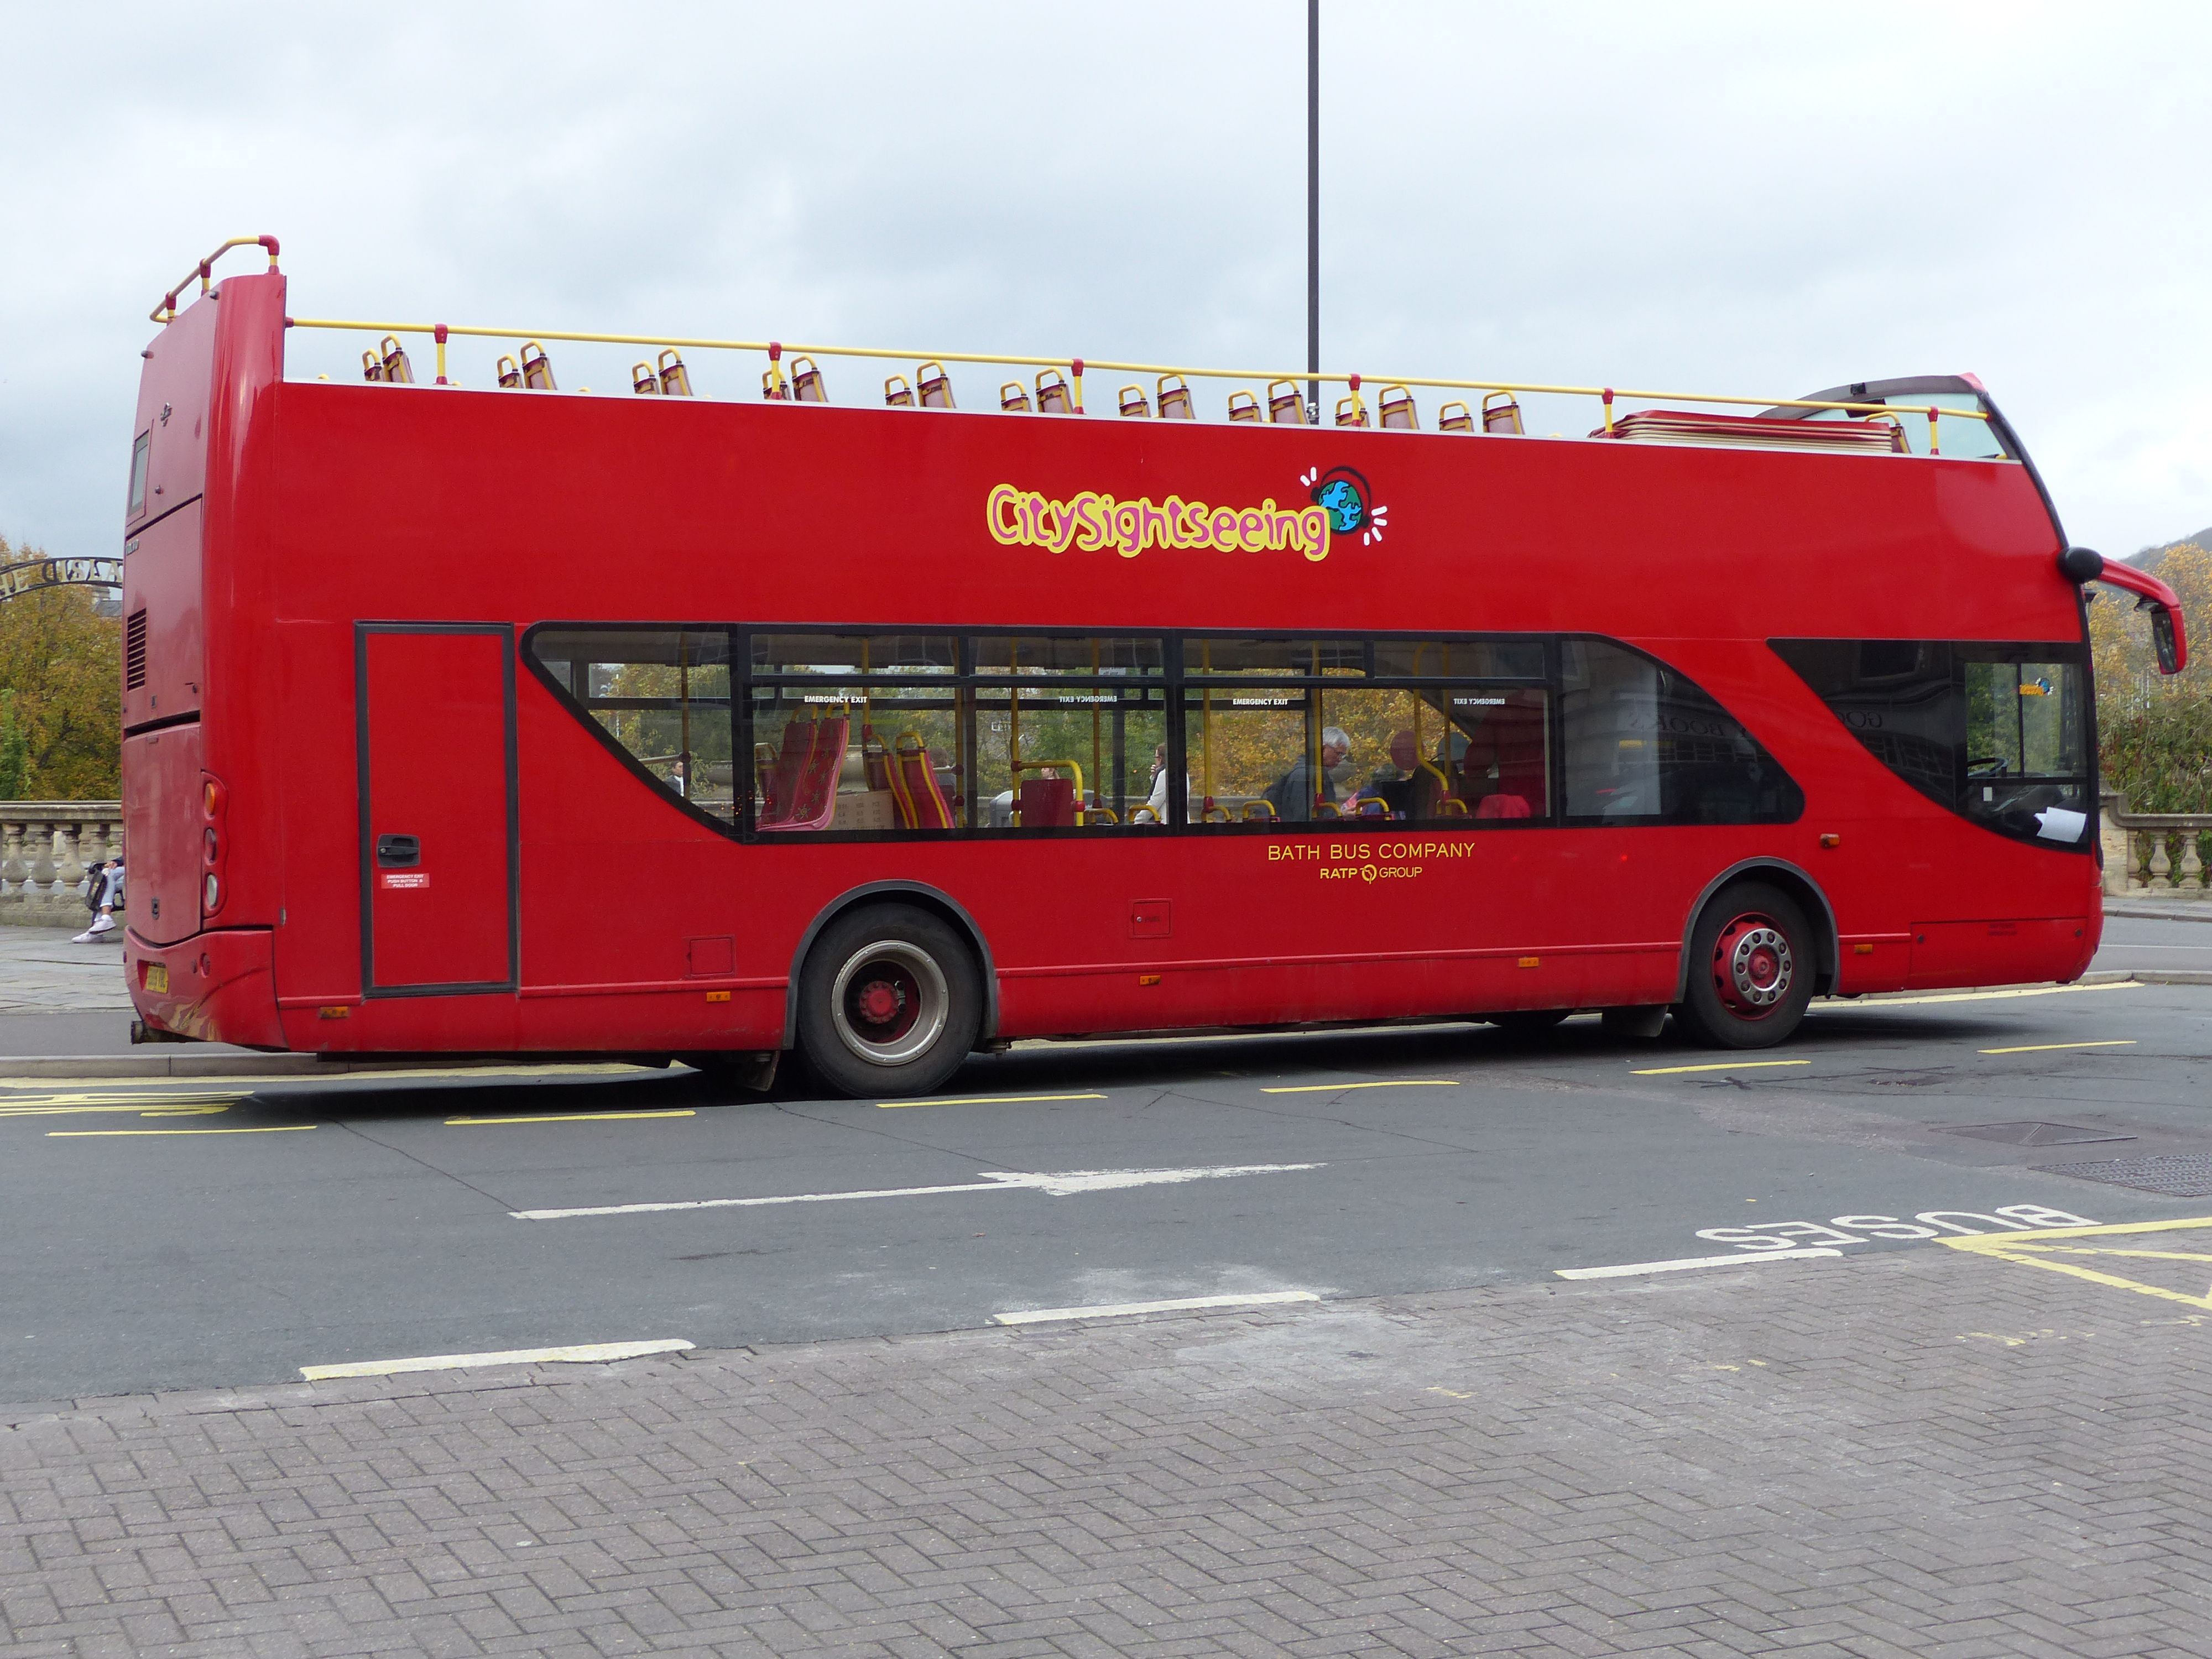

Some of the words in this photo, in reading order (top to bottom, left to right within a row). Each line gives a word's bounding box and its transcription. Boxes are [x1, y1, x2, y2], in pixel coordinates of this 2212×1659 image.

[987, 483, 1331, 561] CitySightseeing
[1267, 844, 1321, 860] BATH
[1330, 844, 1371, 859] BUS
[1378, 842, 1475, 859] COMPANY
[1319, 867, 1358, 879] RATP
[1379, 867, 1423, 878] GROUP
[1695, 1204, 2104, 1251] BUSES
